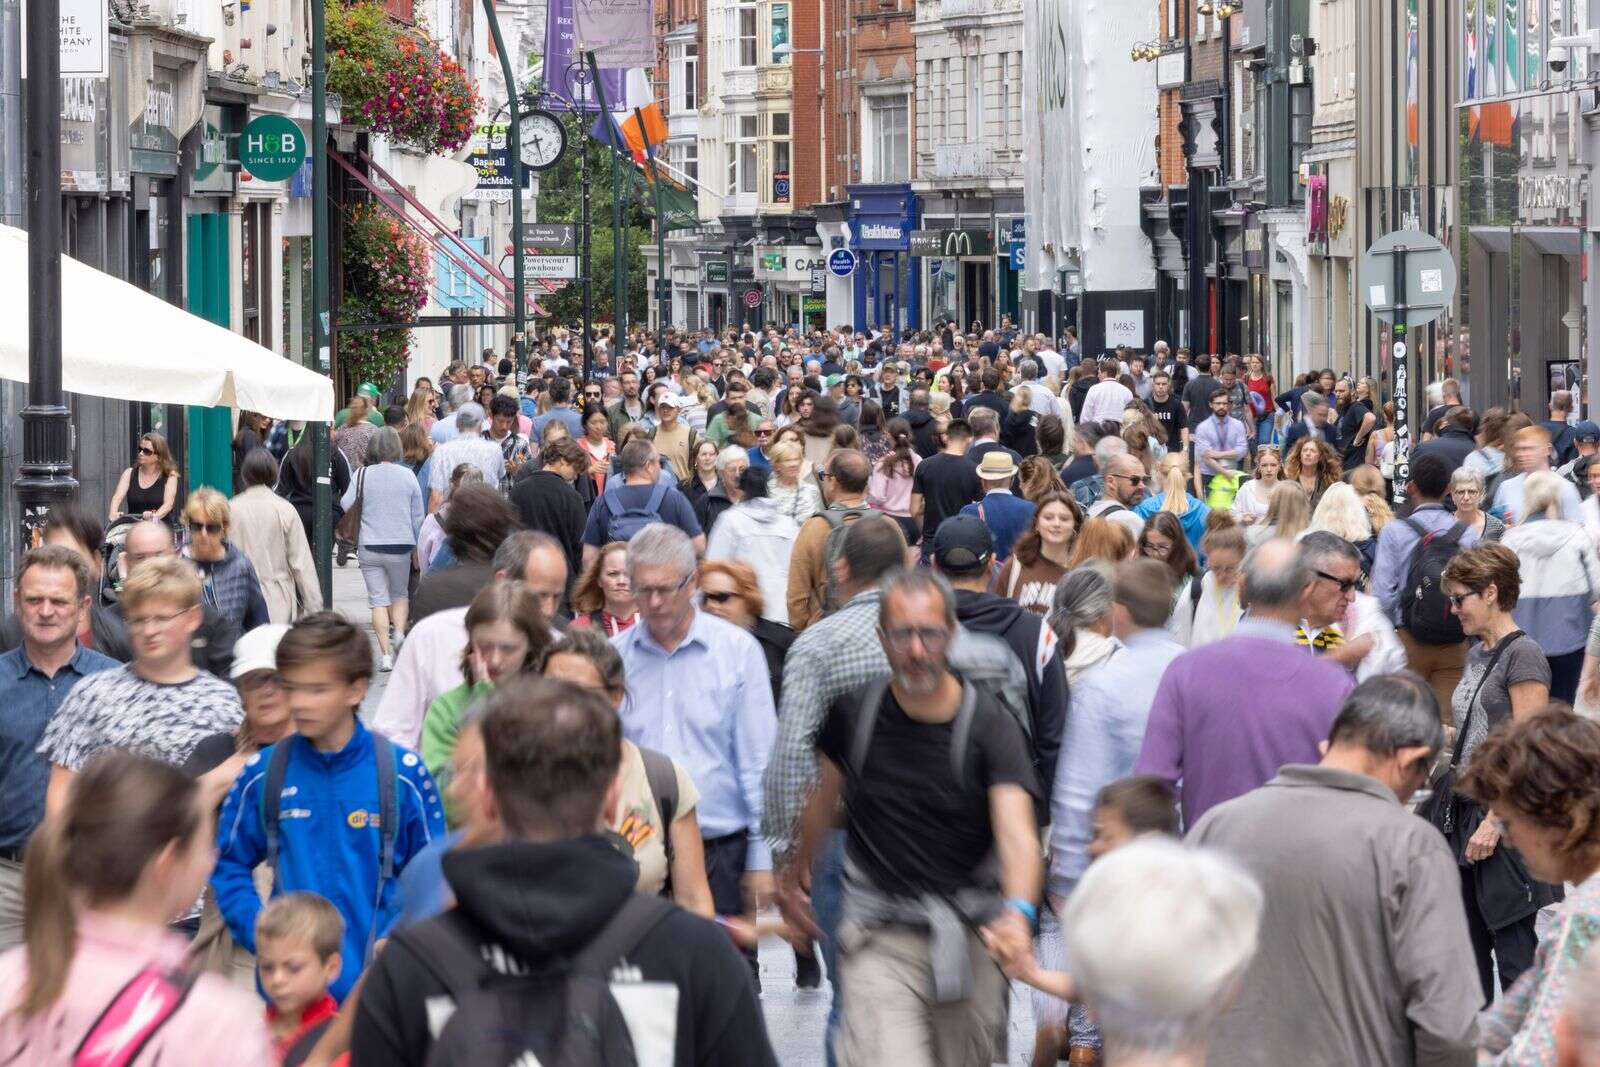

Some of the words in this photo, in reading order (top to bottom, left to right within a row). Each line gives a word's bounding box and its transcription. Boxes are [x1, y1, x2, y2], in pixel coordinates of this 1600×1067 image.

[60, 16, 76, 24] HE
[60, 38, 92, 46] PANY
[248, 134, 296, 153] H&B
[474, 167, 499, 177] Doye
[1112, 321, 1136, 331] M&S
